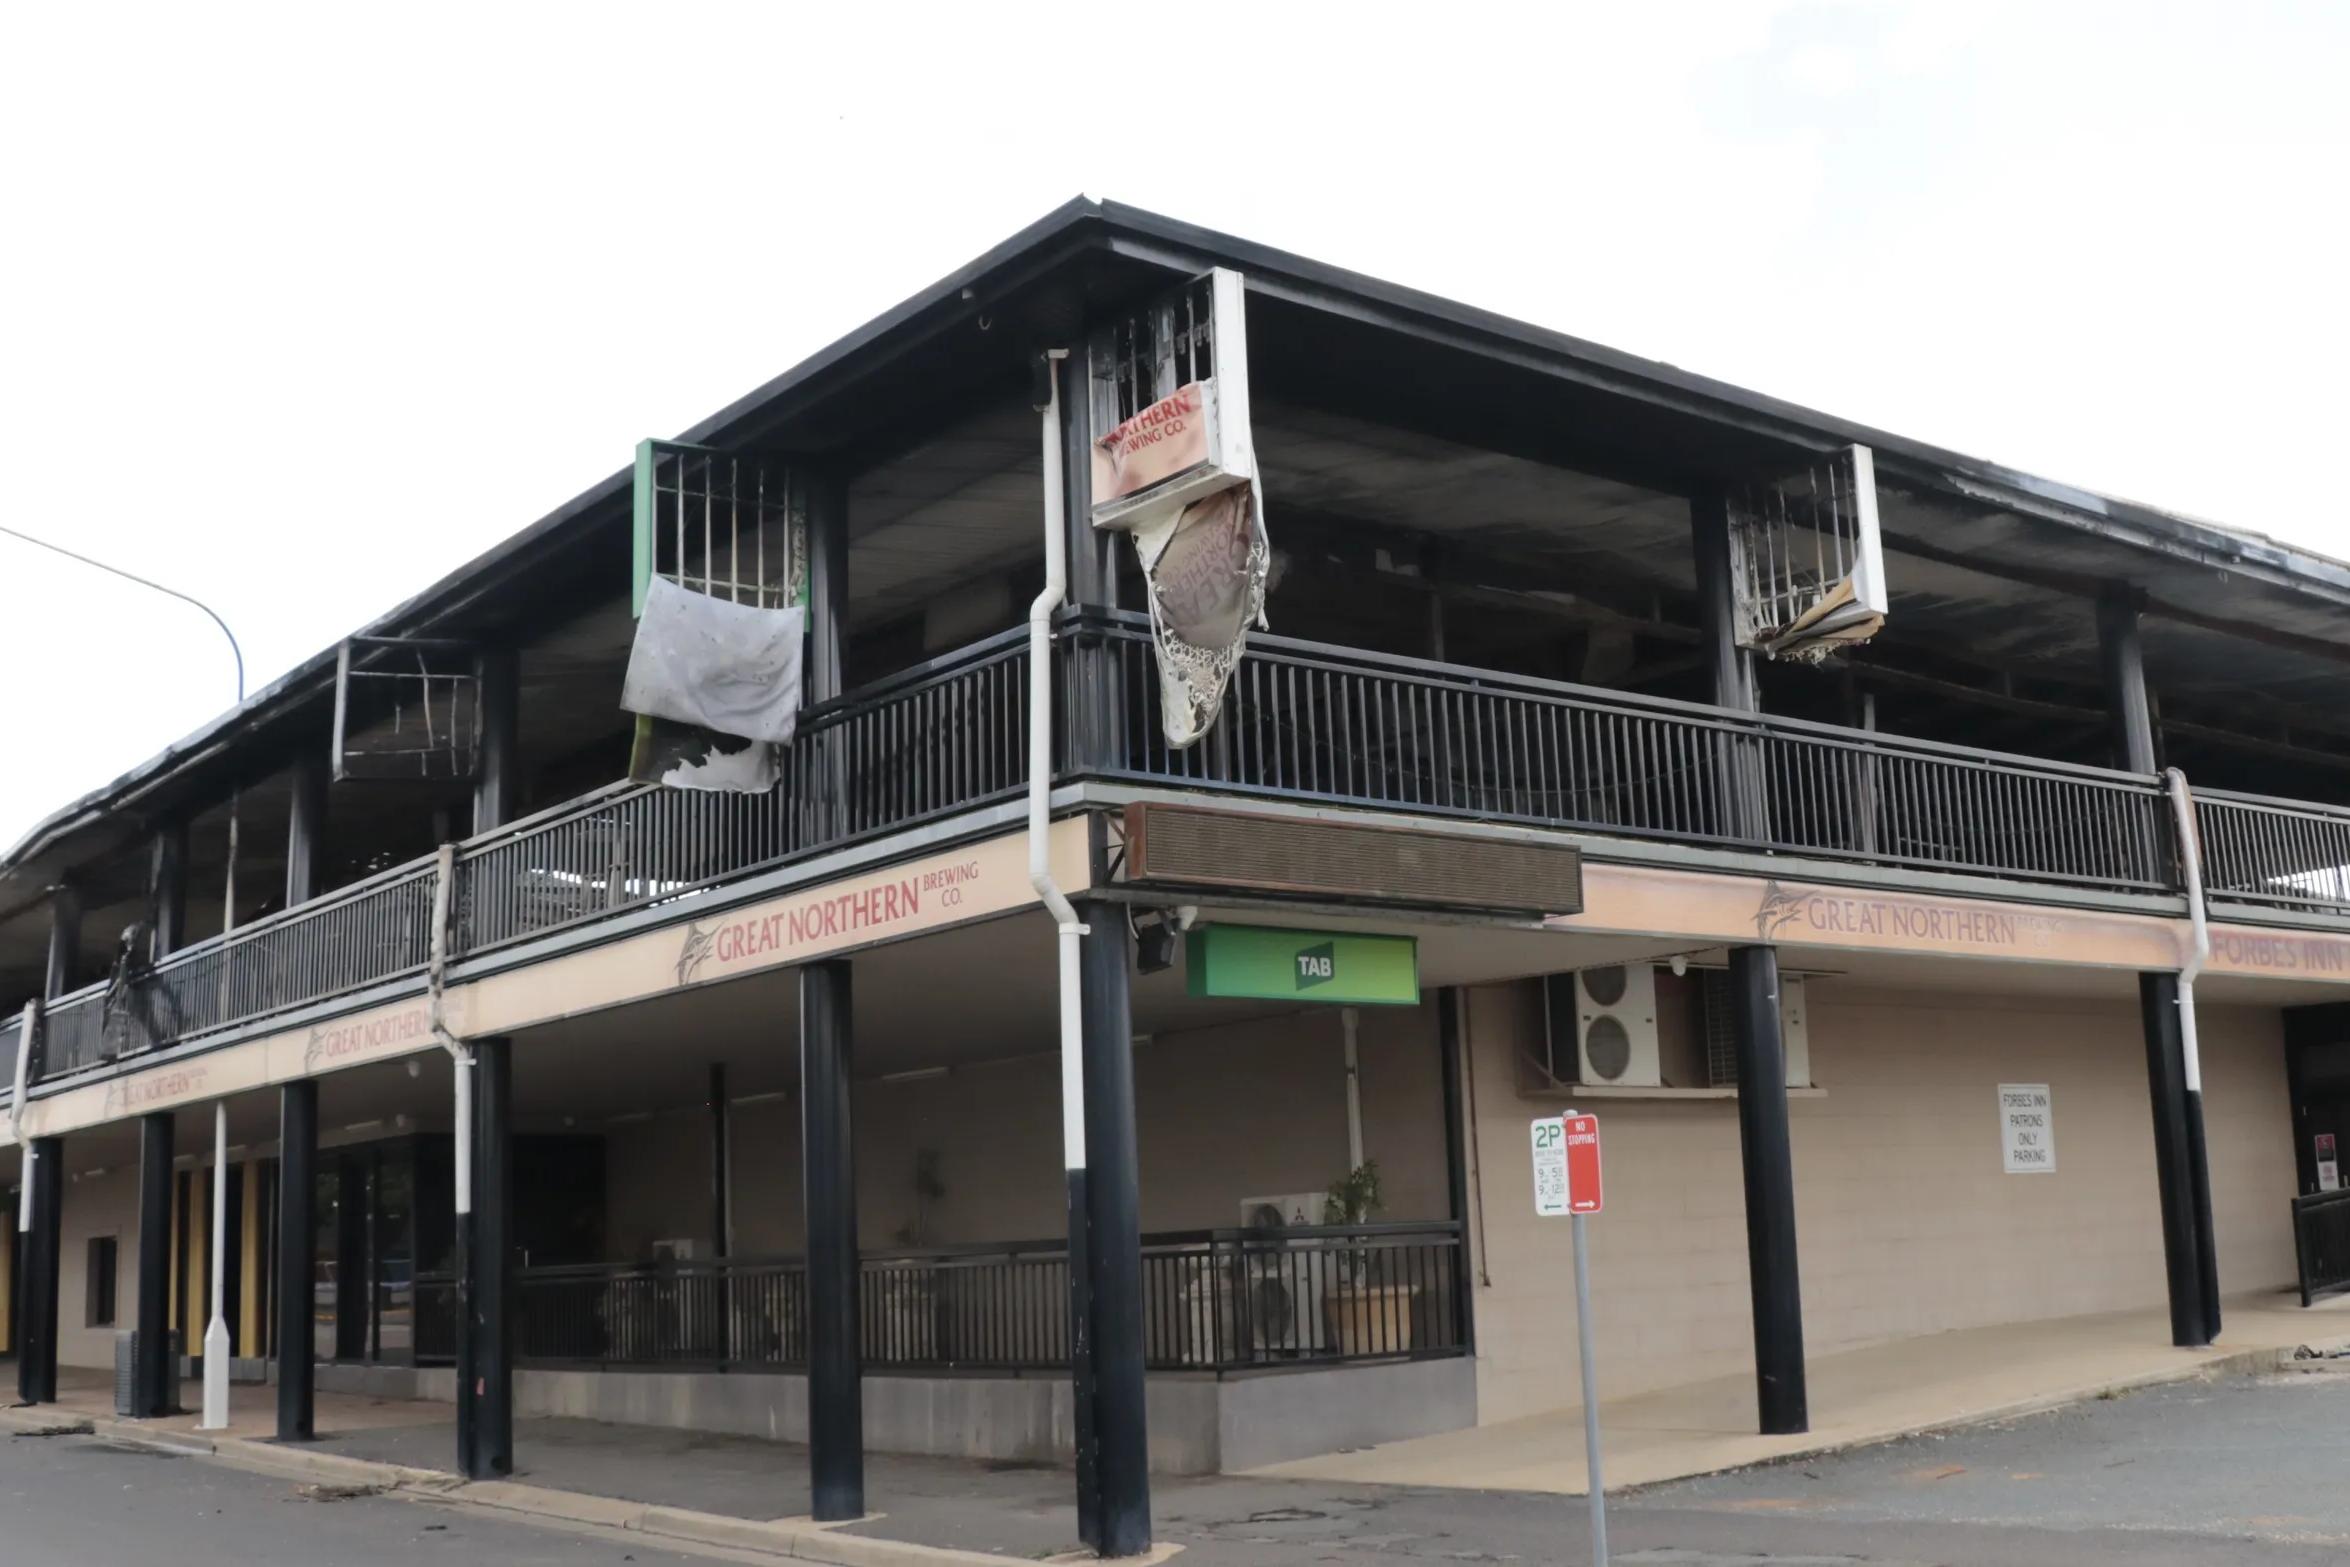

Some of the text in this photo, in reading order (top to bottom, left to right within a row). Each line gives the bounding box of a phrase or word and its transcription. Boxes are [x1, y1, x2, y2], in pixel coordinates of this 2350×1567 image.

[1164, 419, 1187, 437] CO.
[923, 861, 979, 891] BREWING
[941, 887, 963, 908] CO.
[717, 877, 919, 962] GREAT NORTHERN
[1808, 898, 1886, 935] GREAT
[1892, 905, 2015, 945] NORTHERN
[2211, 931, 2344, 971] FORBES INN
[1298, 956, 1332, 977] TAB
[326, 1025, 363, 1057] GREAT
[2003, 1093, 2047, 1107] FORBES INN
[1575, 1120, 1586, 1132] NO
[2010, 1114, 2044, 1128] PATRONS
[1535, 1124, 1561, 1148] 2P
[1567, 1133, 1596, 1146] STOPPING
[2018, 1132, 2038, 1146] ONLY
[2013, 1149, 2046, 1163] PARKING
